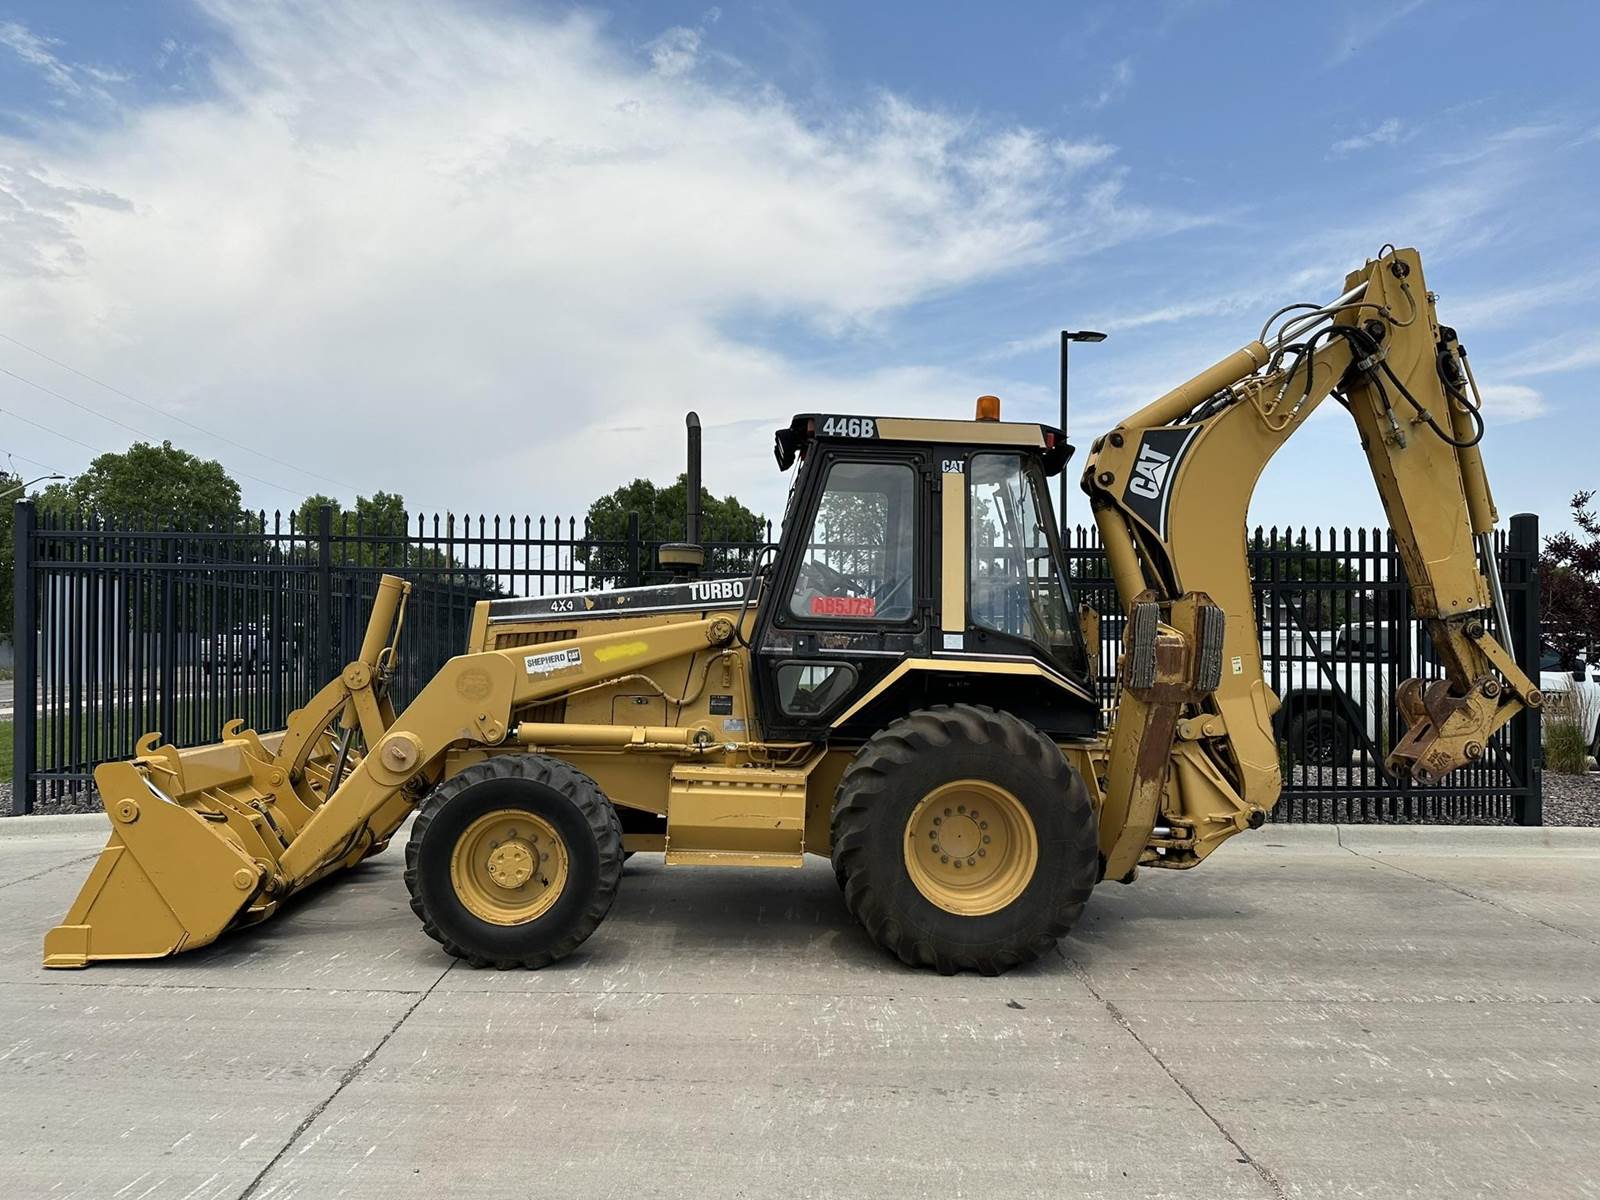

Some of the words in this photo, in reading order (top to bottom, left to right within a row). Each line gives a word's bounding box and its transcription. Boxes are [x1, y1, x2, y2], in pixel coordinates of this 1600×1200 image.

[823, 418, 874, 438] 446B
[942, 460, 965, 473] CAT
[1130, 443, 1171, 499] CAT
[688, 580, 744, 601] TURBO
[550, 600, 573, 612] 4X4
[527, 653, 566, 667] SHEPHERD
[568, 650, 580, 661] CAT
